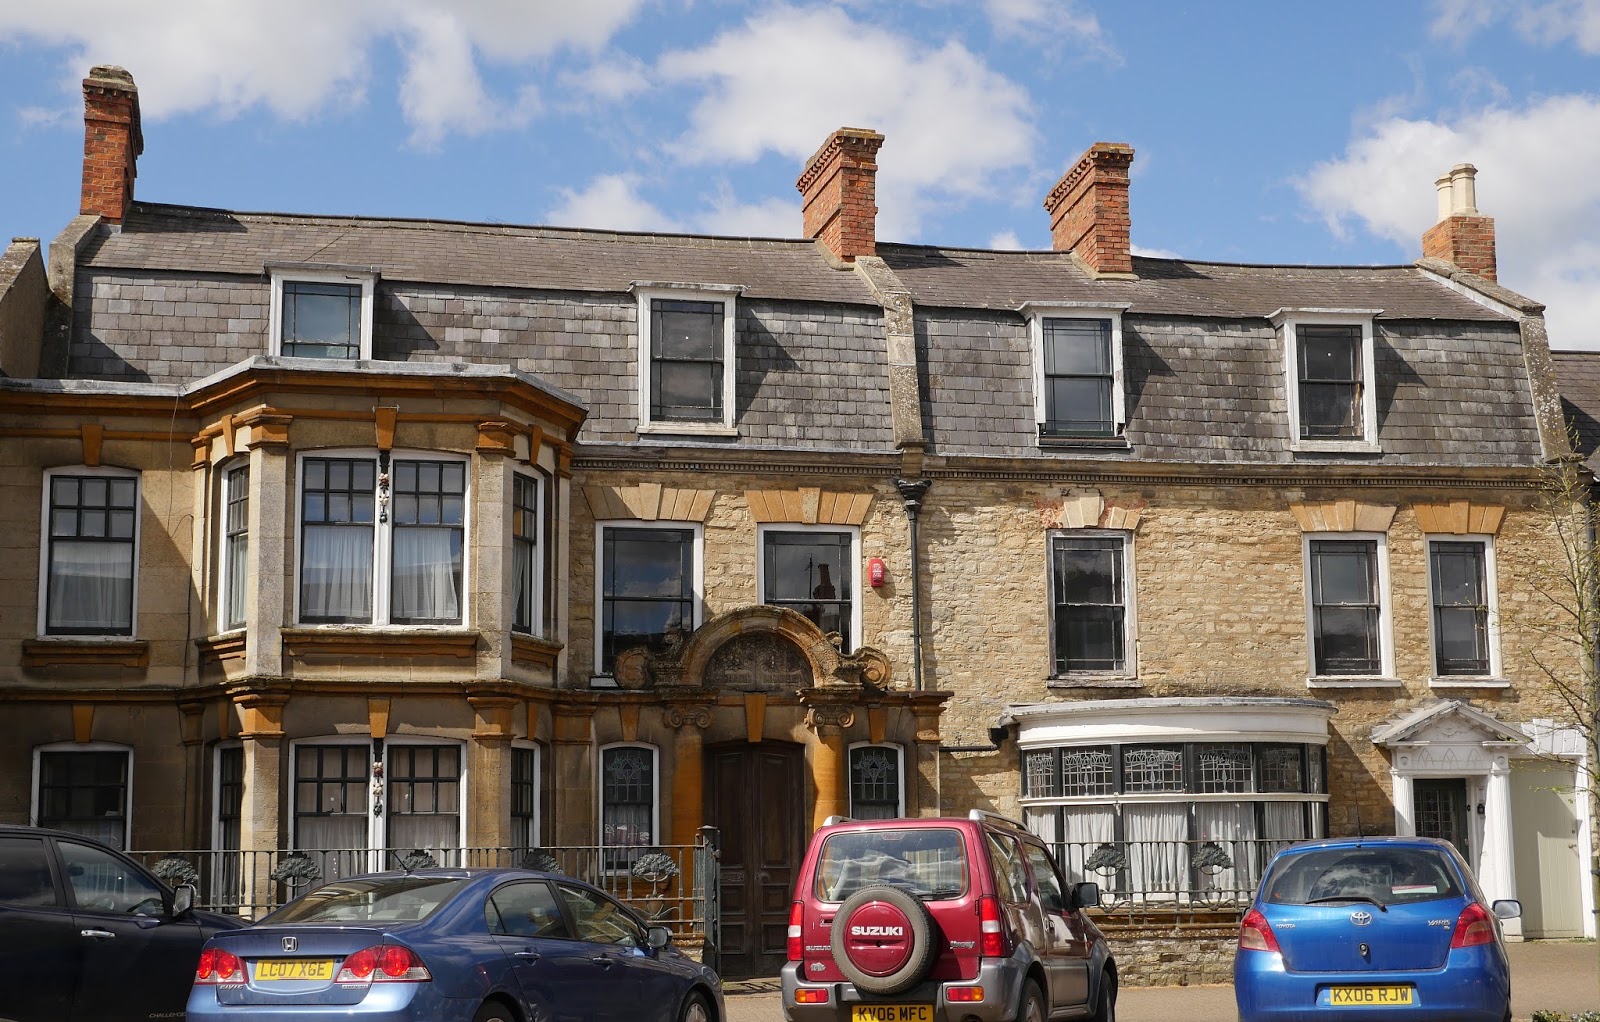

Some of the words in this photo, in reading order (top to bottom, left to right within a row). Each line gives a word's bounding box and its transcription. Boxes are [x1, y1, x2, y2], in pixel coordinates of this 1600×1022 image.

[851, 926, 903, 936] SUZUKI
[260, 961, 296, 977] LC07
[298, 961, 327, 977] XGE
[1333, 988, 1373, 1002] KX06
[1379, 988, 1409, 1002] RJW
[858, 1006, 895, 1021] KV06
[899, 1006, 927, 1021] MFC
